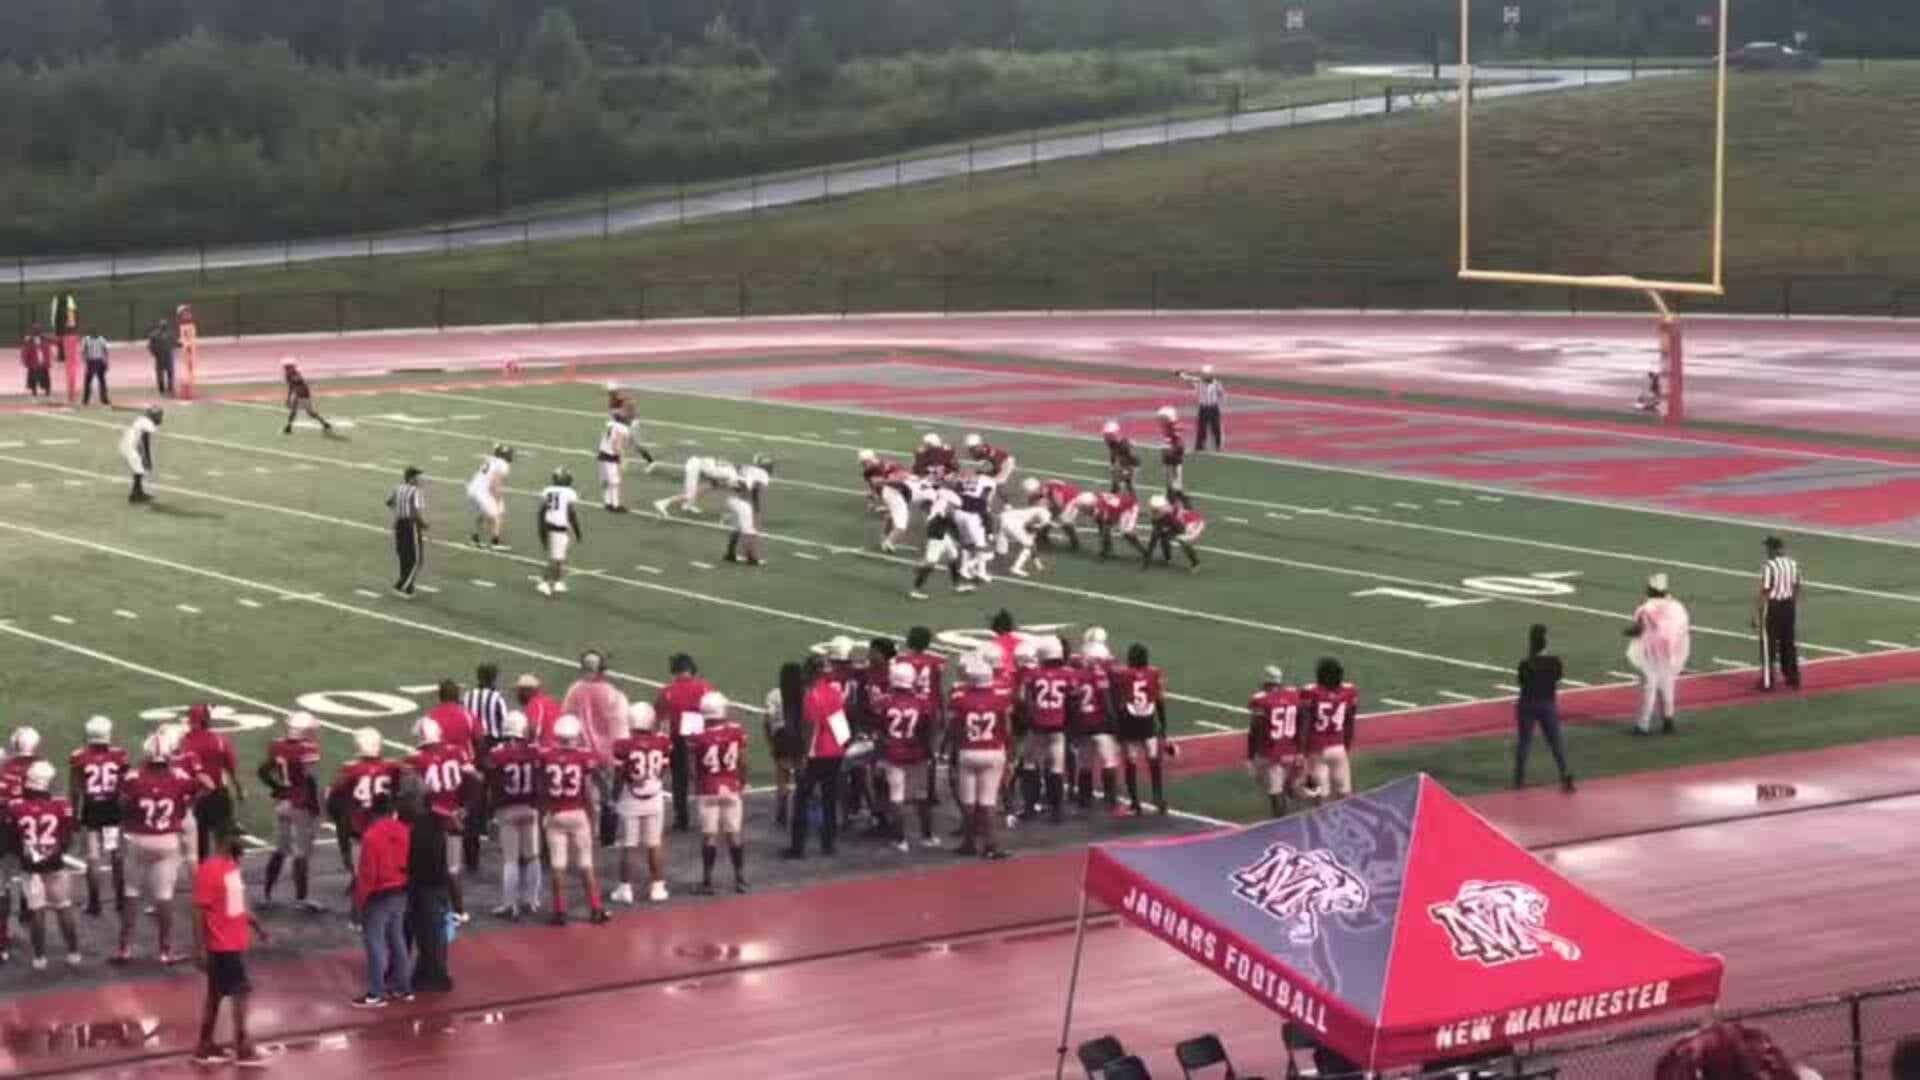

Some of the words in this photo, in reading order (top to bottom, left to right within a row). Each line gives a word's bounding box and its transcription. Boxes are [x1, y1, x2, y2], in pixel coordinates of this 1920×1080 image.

[1347, 575, 1575, 609] 10
[1035, 679, 1067, 709] 25
[1132, 679, 1148, 707] 5
[888, 707, 918, 739] 27
[1270, 705, 1297, 739] 50
[1315, 701, 1346, 732] 54
[703, 739, 738, 773] 44
[85, 762, 119, 793] 26
[425, 760, 461, 792] 40
[503, 762, 531, 795] 31
[545, 765, 582, 796] 33
[18, 814, 58, 846] 32
[1122, 887, 1217, 961] JAGUARS
[1224, 944, 1328, 1033] FOOTBALL
[1436, 1015, 1496, 1049] NEW
[1505, 980, 1671, 1036] MANCHESTER
